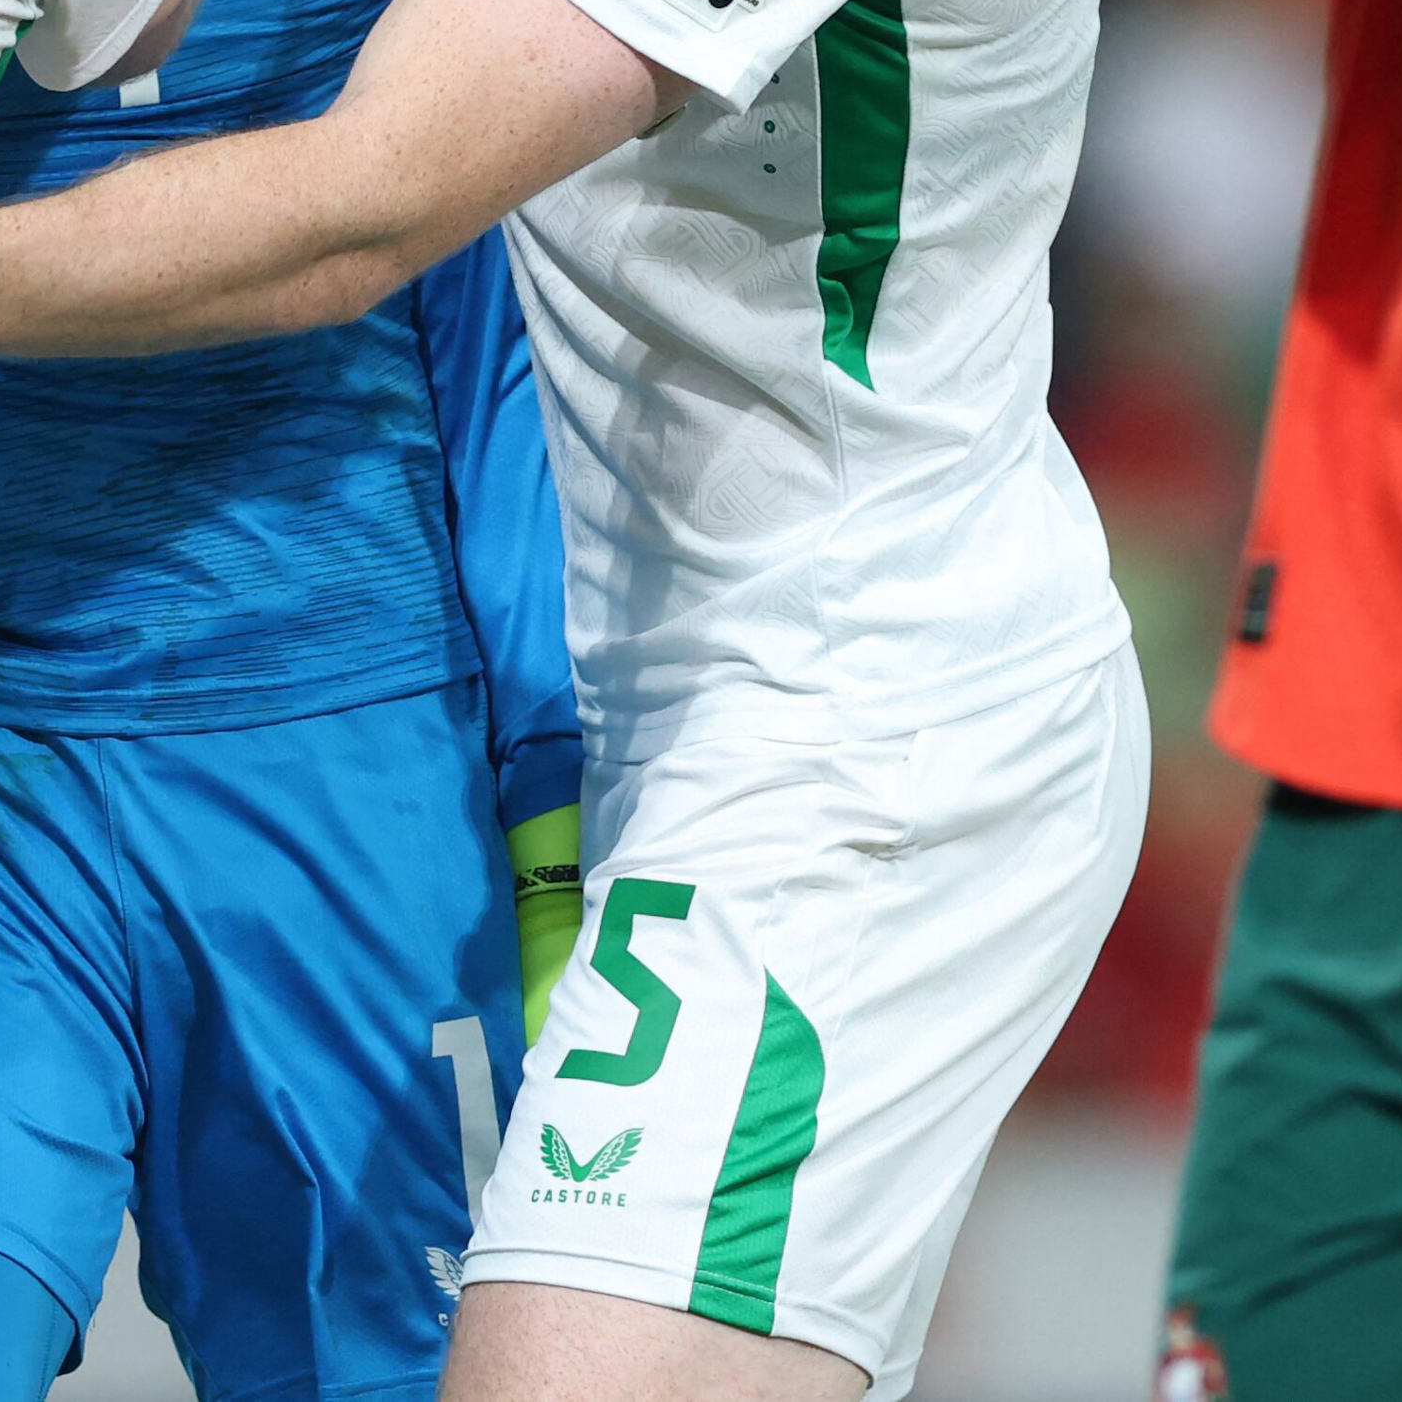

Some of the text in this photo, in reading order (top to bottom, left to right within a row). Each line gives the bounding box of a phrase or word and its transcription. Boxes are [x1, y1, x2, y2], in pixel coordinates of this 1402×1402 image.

[555, 878, 696, 1086] 5
[432, 1015, 501, 1231] 1
[531, 1189, 628, 1208] CASTORE
